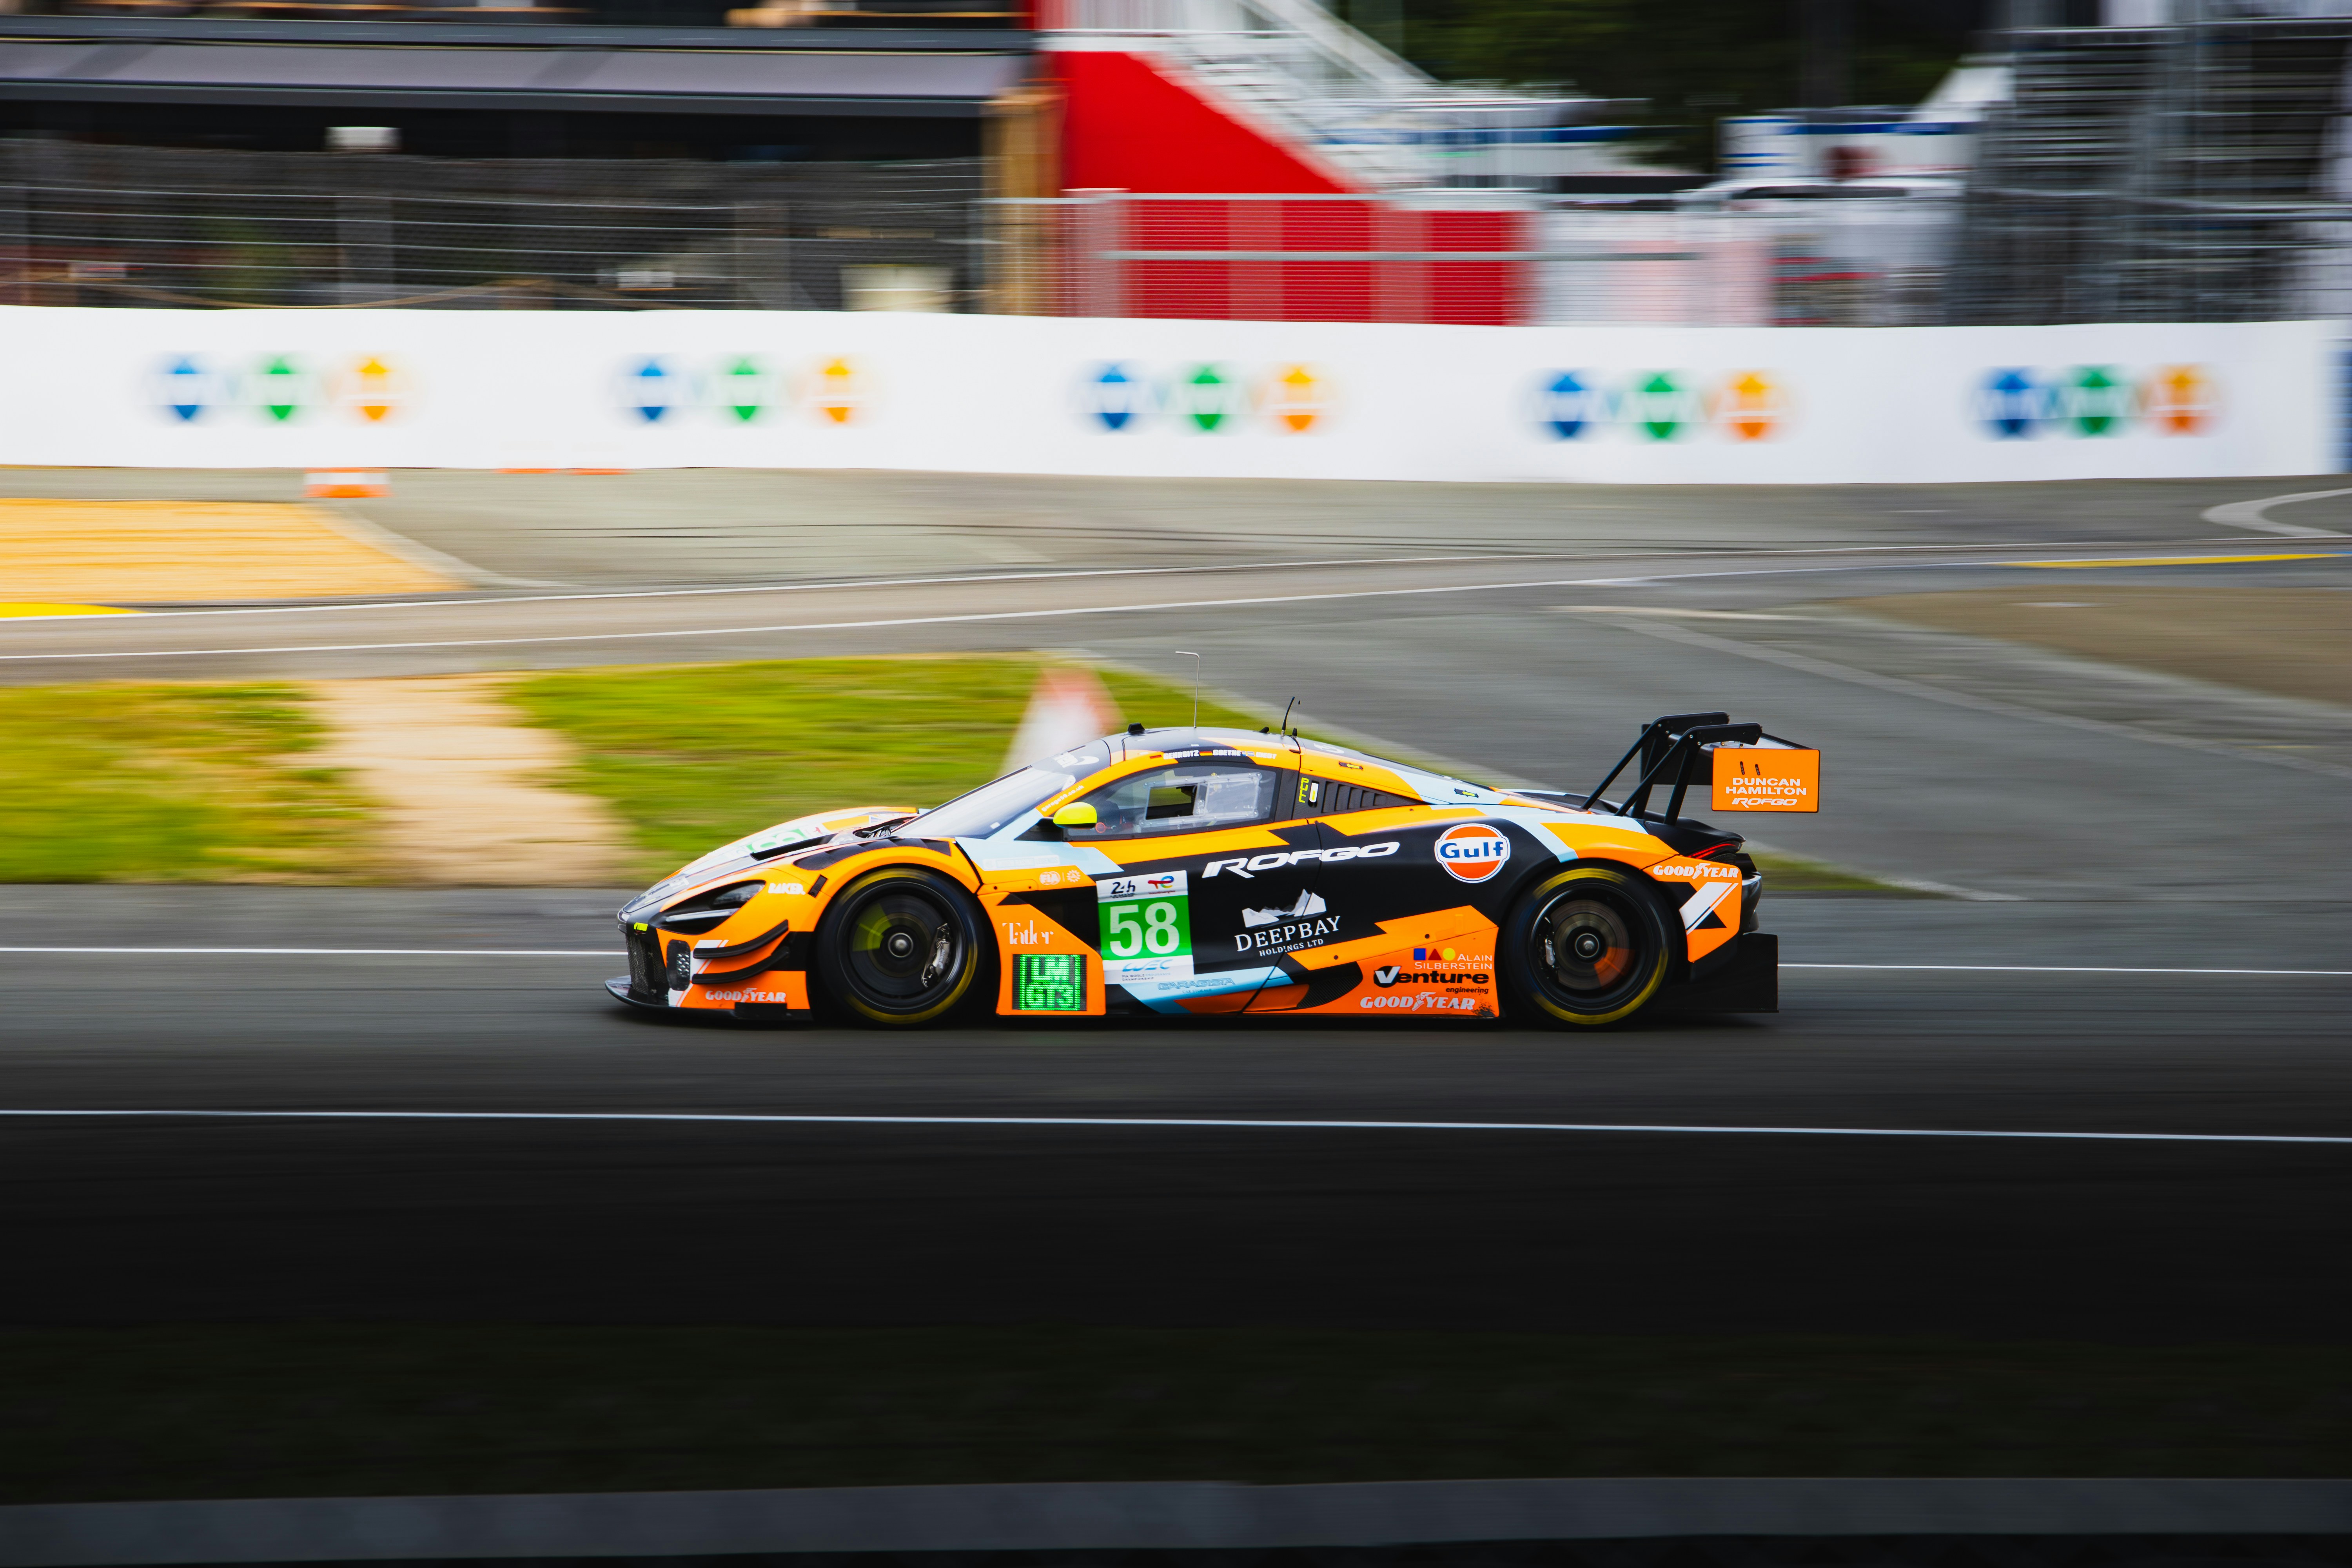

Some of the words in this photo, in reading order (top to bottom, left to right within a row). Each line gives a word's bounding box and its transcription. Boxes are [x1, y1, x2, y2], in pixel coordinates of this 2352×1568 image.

[1733, 777, 1800, 786] DUNCAN
[1298, 777, 1309, 803] PULL
[1726, 786, 1807, 795] HAMILTON
[1731, 798, 1797, 808] ROFGO
[1439, 841, 1504, 858] Gulf
[1201, 841, 1400, 878] ROFGO
[1040, 872, 1060, 884] FIA
[1653, 864, 1739, 878] GOODYEAR
[1109, 902, 1180, 957] 58
[1234, 916, 1341, 952] DEEPBAY
[1259, 942, 1305, 957] HOLDINGS
[1307, 938, 1324, 948] LTD
[1457, 953, 1492, 962] ALAIN
[1031, 956, 1069, 982] LM
[1414, 962, 1492, 970] SILBERSTEIN
[1374, 966, 1489, 985] Venture
[705, 989, 787, 1002] GOODYEAR
[1026, 983, 1074, 1008] GT3
[1360, 996, 1475, 1010] GOODYEAR
